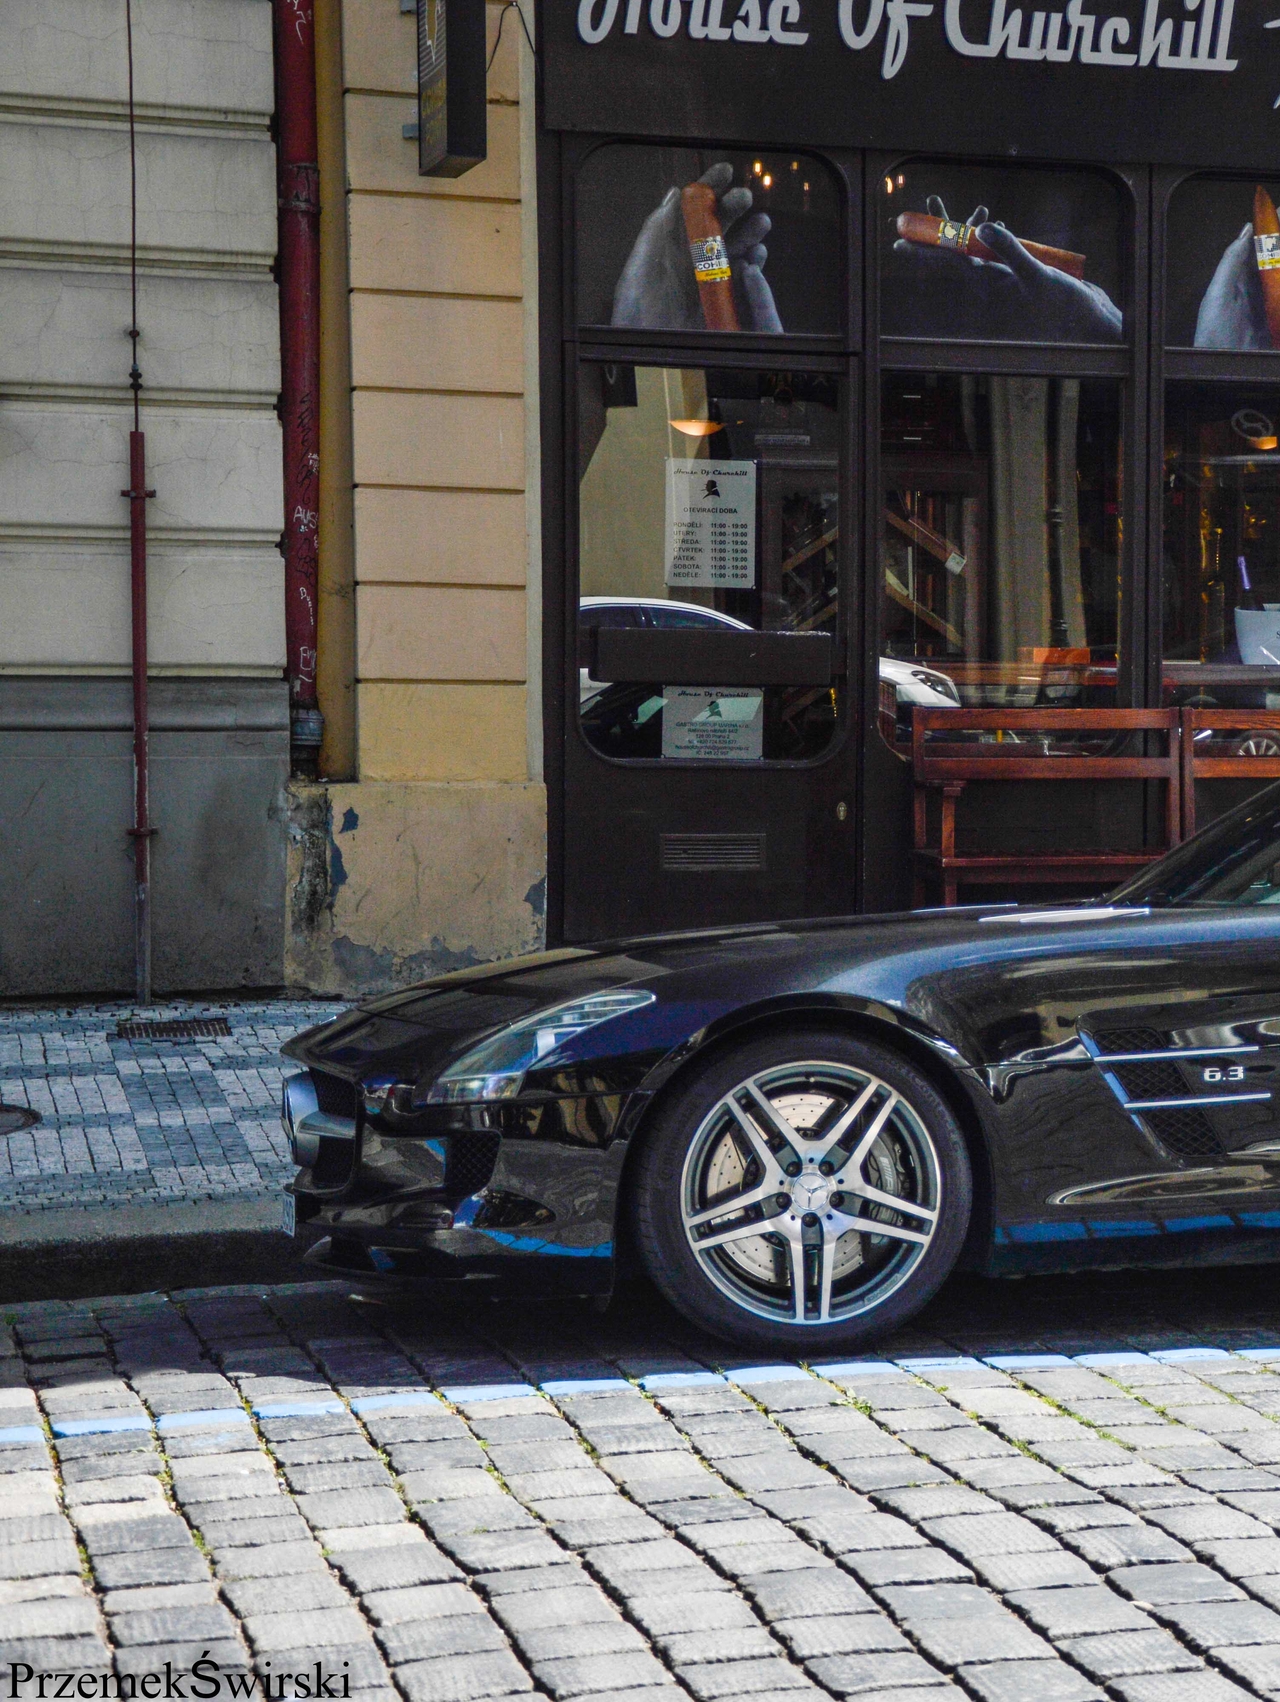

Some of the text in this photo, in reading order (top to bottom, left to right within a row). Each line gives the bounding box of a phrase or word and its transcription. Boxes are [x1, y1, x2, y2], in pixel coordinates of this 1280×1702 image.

[577, 0, 1238, 80] House Of Churchill
[1203, 1066, 1244, 1081] 6.3
